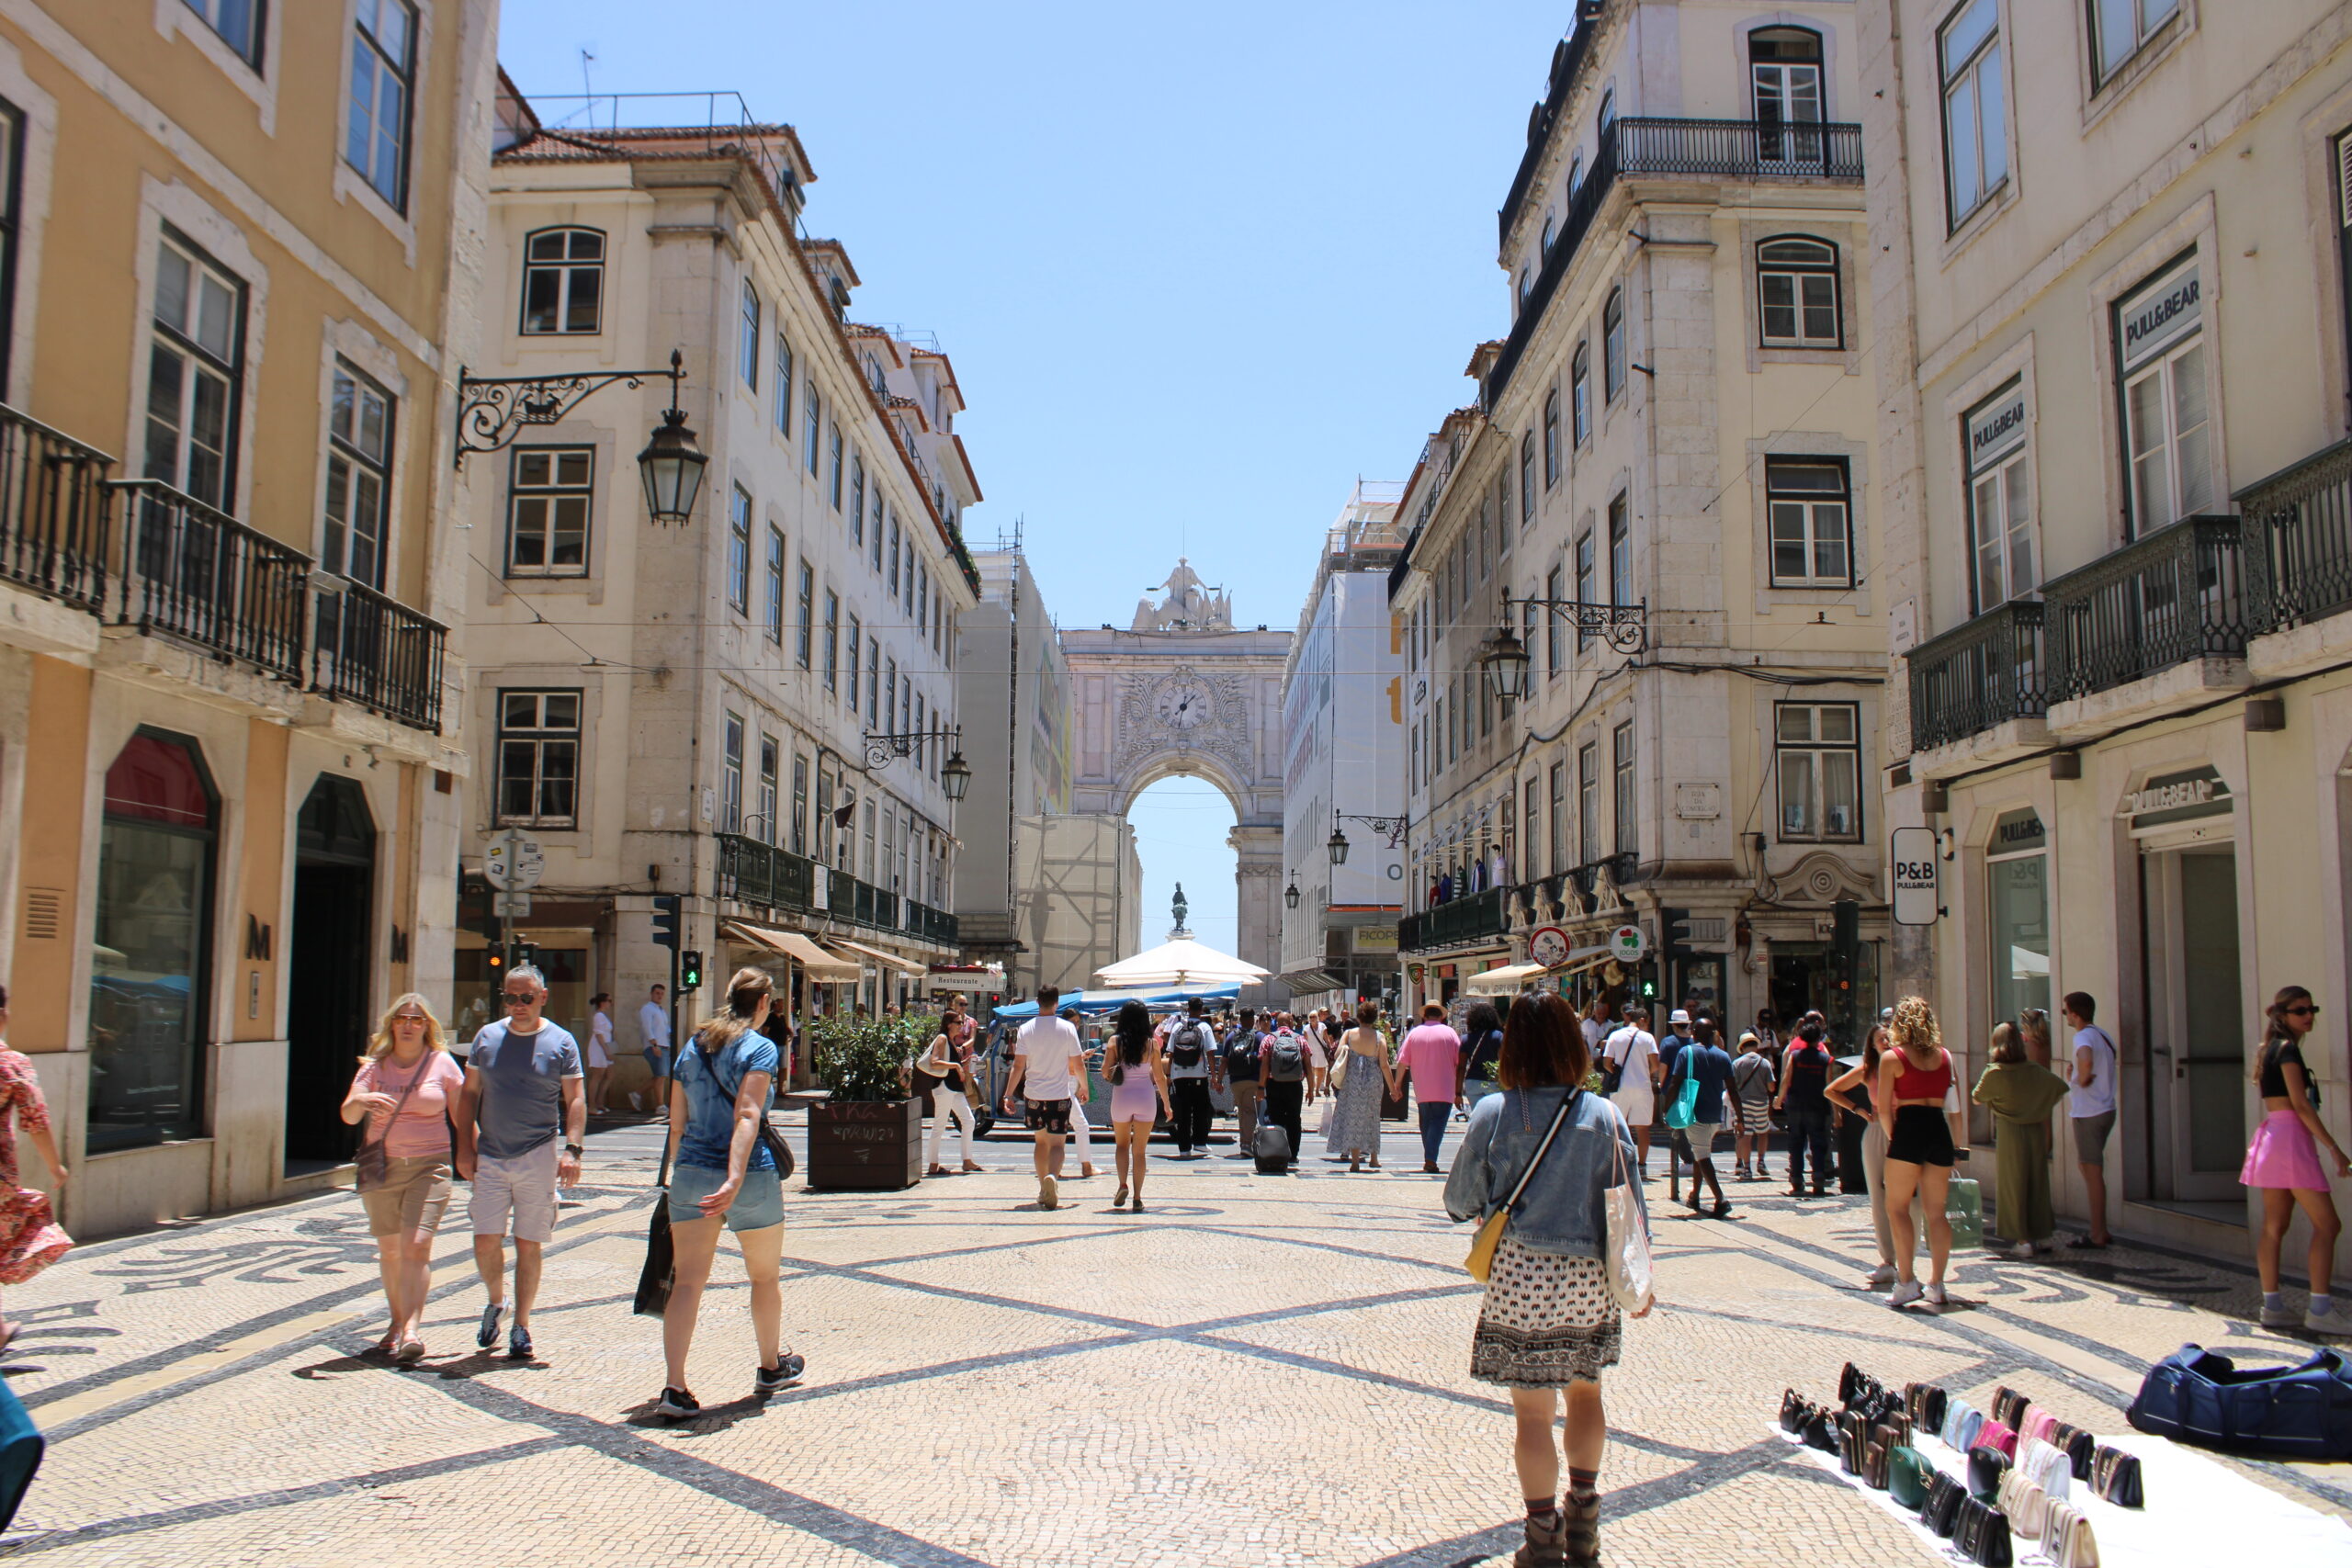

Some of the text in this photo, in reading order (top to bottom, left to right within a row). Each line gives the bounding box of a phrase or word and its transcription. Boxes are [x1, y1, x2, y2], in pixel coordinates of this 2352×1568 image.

[2126, 279, 2199, 346] PULL&BEAR
[1973, 401, 2024, 452] PULL&BEAR
[2132, 779, 2207, 813] PULL&BEAR
[1896, 862, 1934, 880] P&B
[244, 912, 272, 961] M
[938, 976, 978, 985] Restaurante
